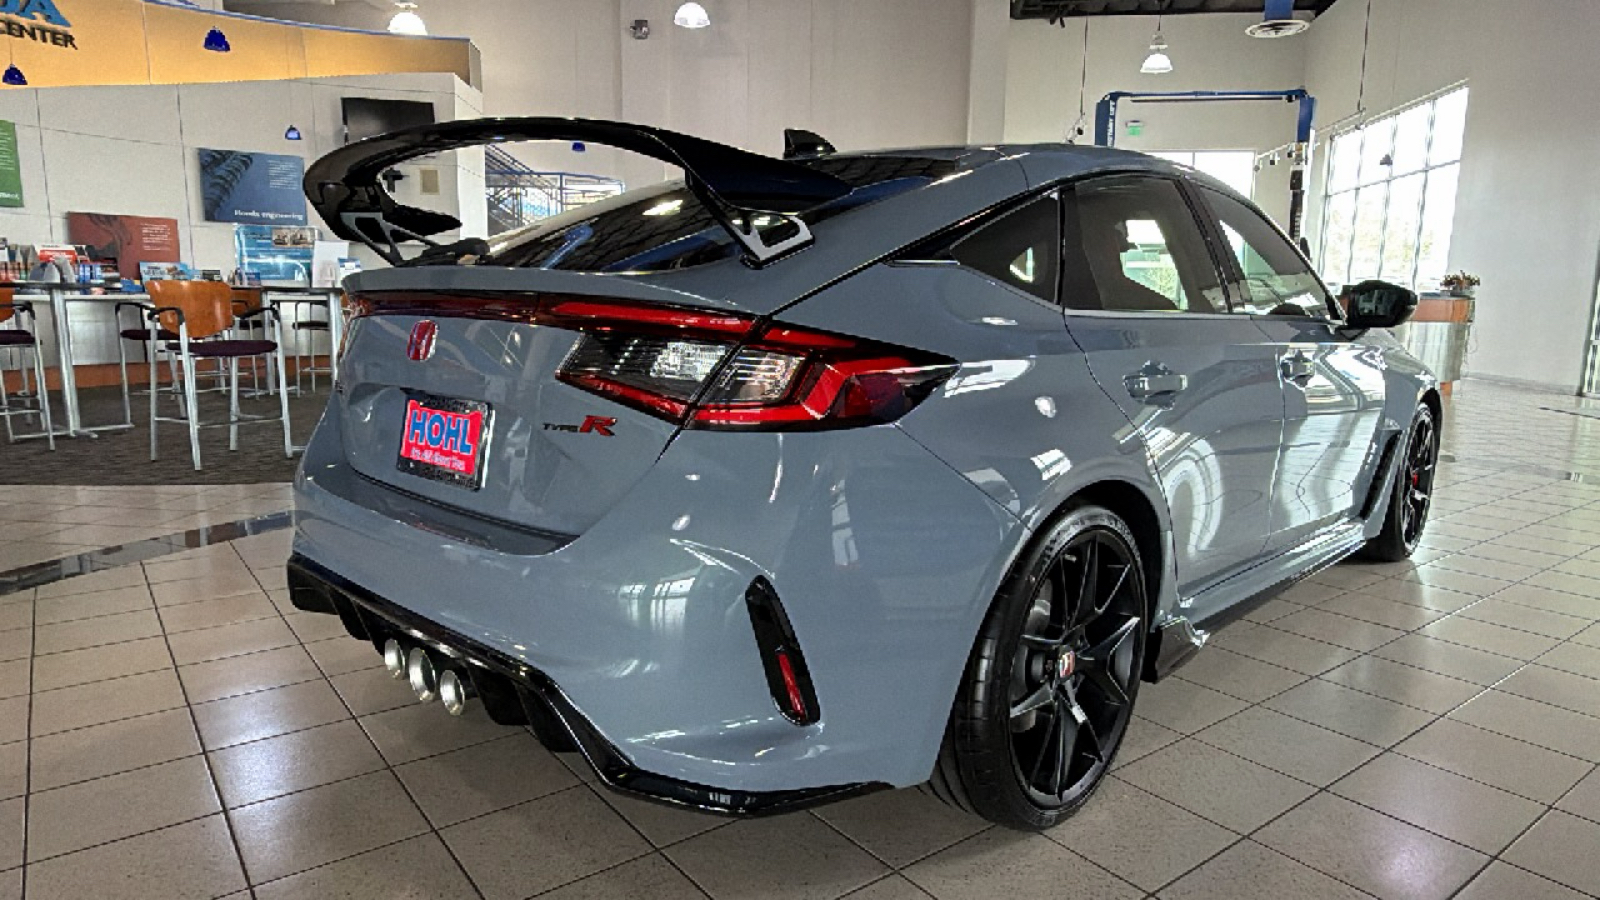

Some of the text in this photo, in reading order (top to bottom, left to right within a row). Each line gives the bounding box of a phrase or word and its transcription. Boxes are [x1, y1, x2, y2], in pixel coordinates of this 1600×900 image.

[234, 209, 303, 221] Honda engineering
[409, 410, 472, 455] HOHL
[543, 415, 618, 436] TYPE R
